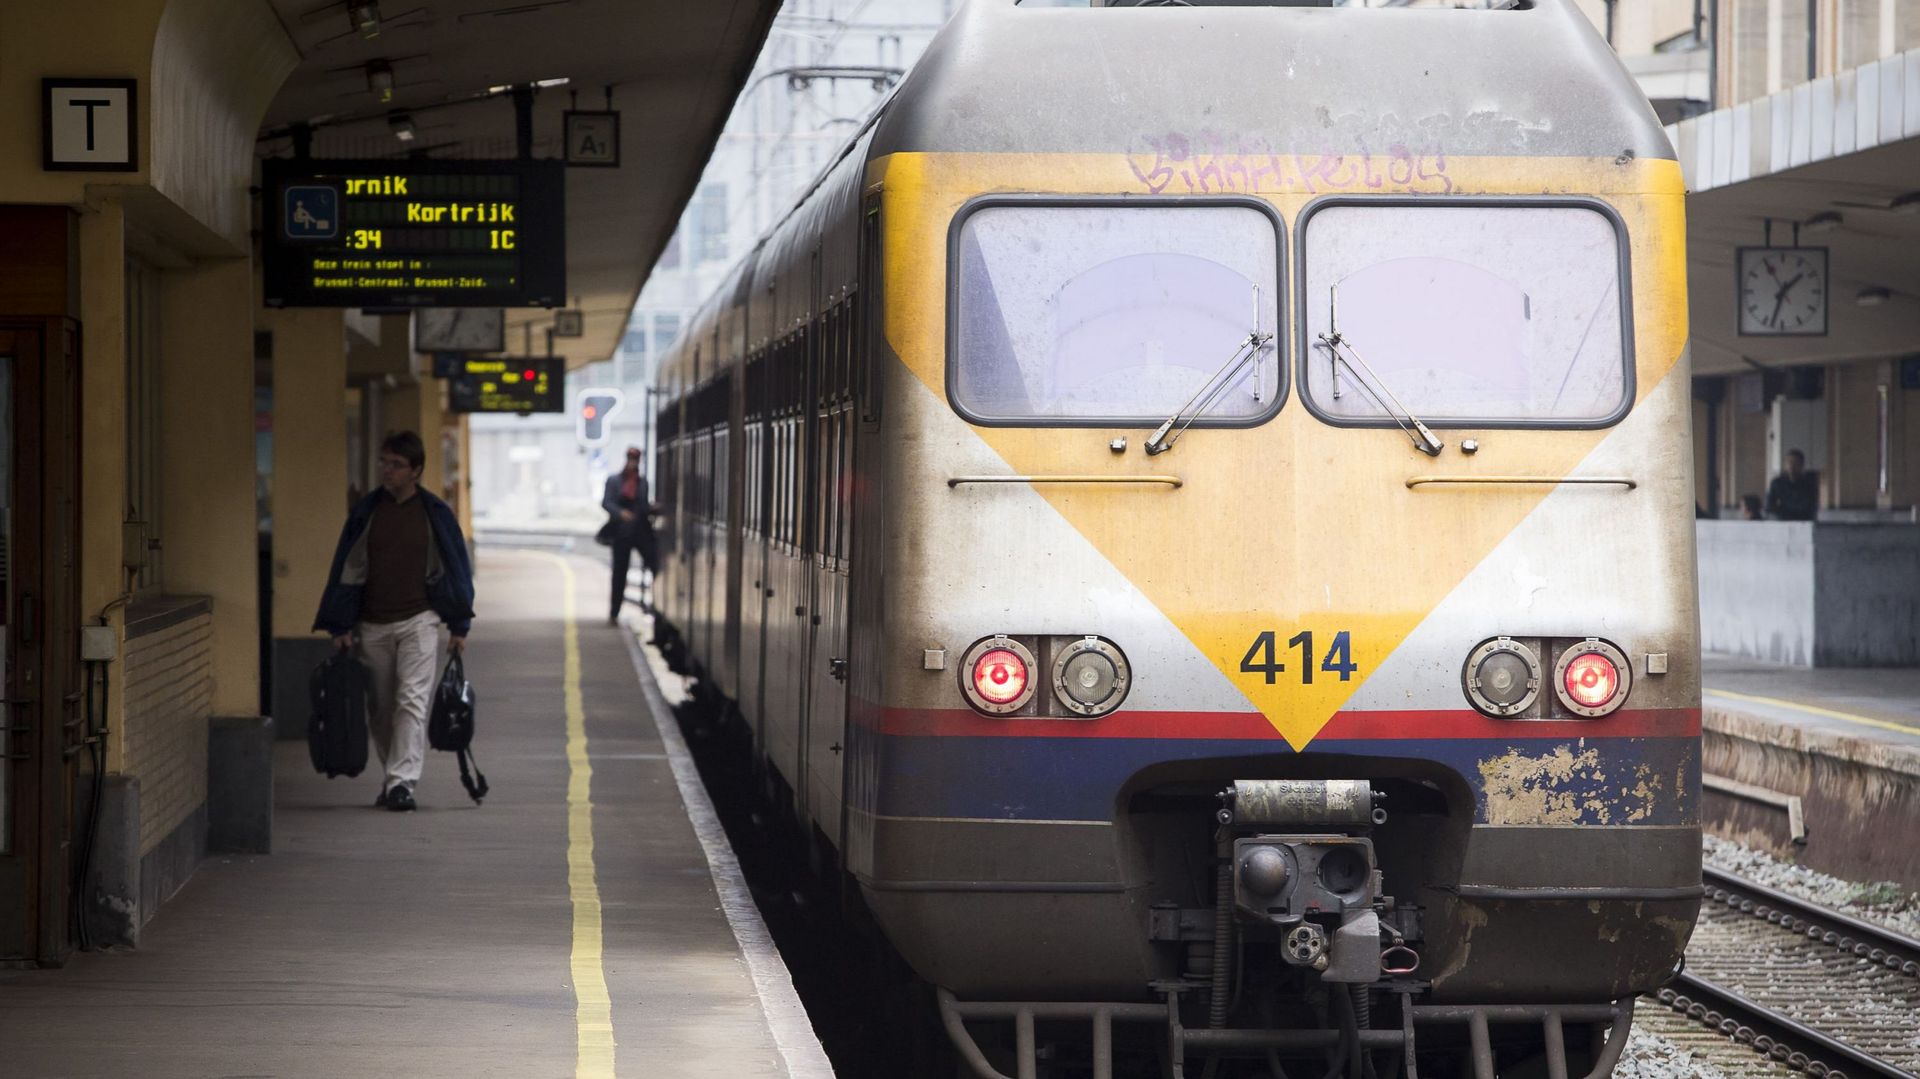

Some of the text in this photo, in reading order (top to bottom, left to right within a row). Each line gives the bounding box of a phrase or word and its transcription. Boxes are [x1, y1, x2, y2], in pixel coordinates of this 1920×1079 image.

[69, 99, 110, 151] T
[407, 203, 514, 222] Kortrijk
[490, 230, 514, 249] IC
[343, 260, 371, 269] trein
[1240, 631, 1357, 684] 414
